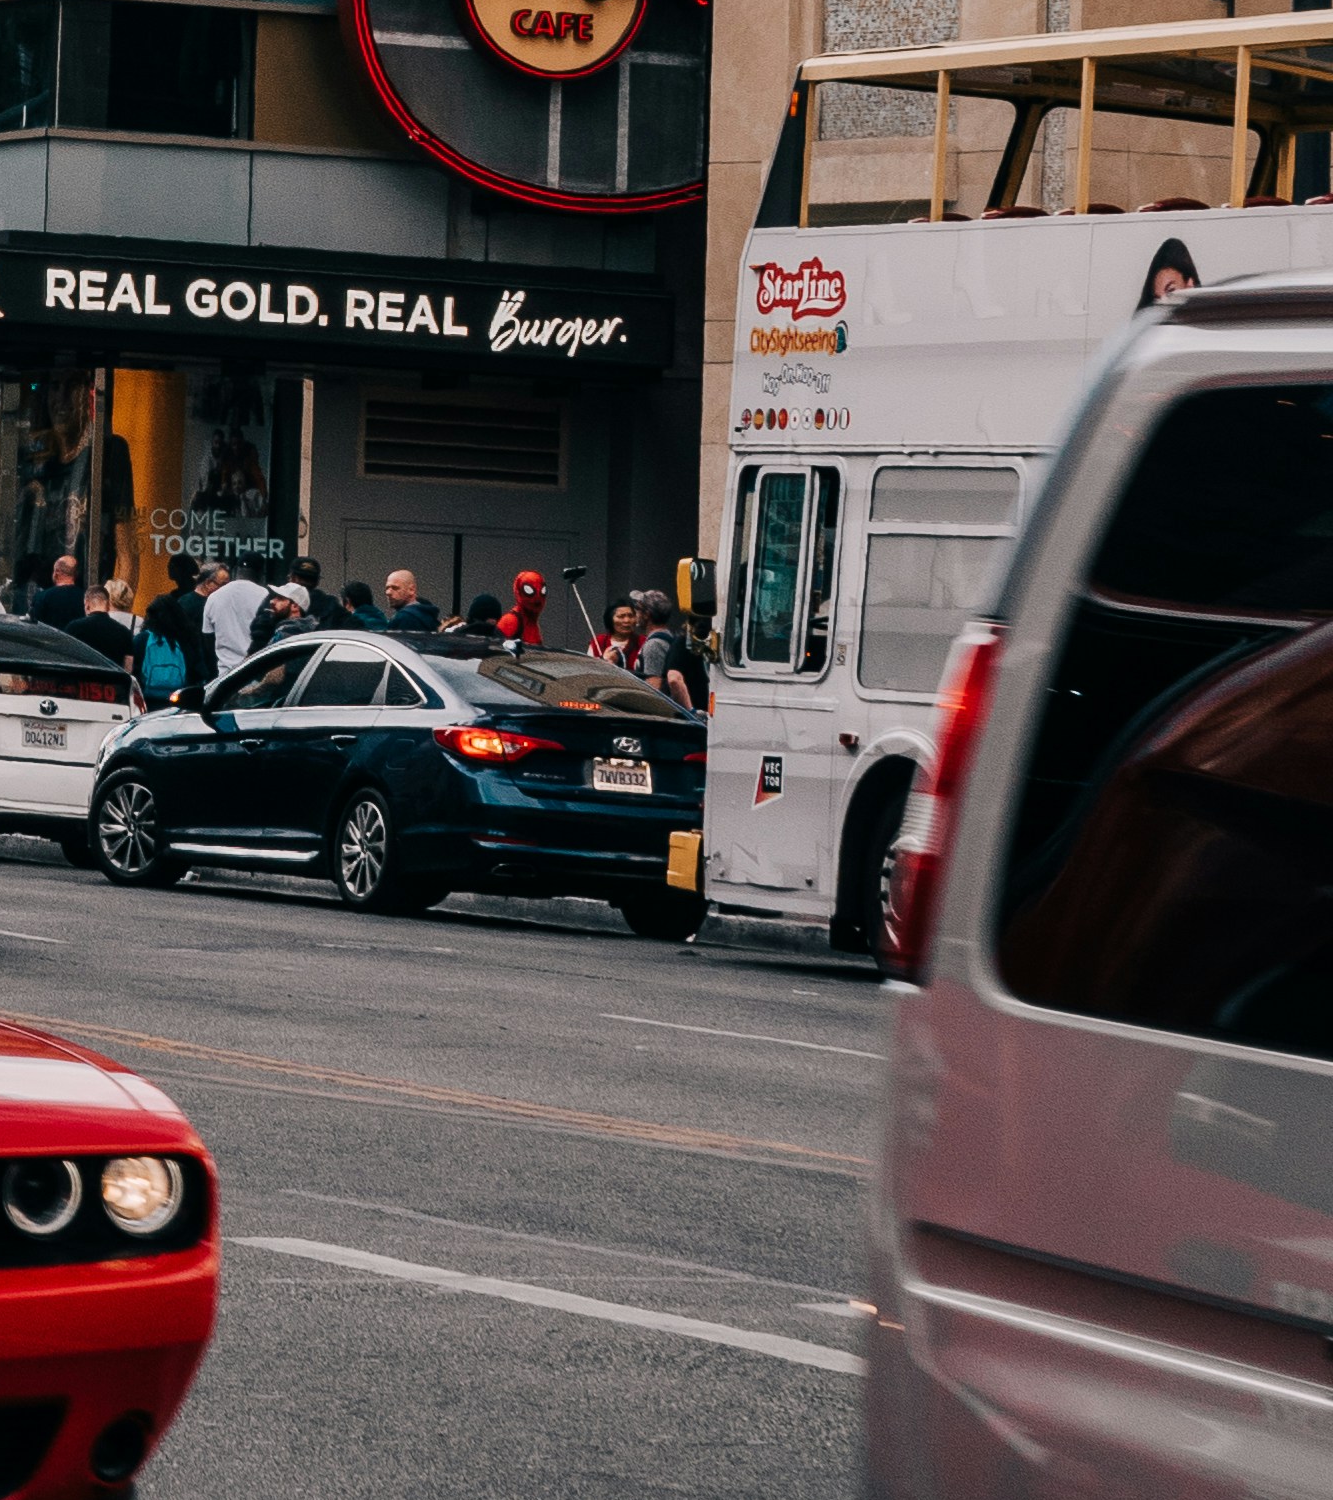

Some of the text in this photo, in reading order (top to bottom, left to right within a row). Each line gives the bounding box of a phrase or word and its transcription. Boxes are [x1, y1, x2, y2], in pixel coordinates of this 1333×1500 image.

[511, 8, 594, 43] CAFE
[759, 268, 843, 314] StarLine
[45, 267, 628, 358] REAL GOLD. REAL Burger.
[749, 325, 838, 357] CitySightseeing
[149, 507, 227, 533] COME
[149, 534, 285, 560] TOGETHER
[764, 762, 781, 773] VEC
[764, 775, 781, 787] TOR
